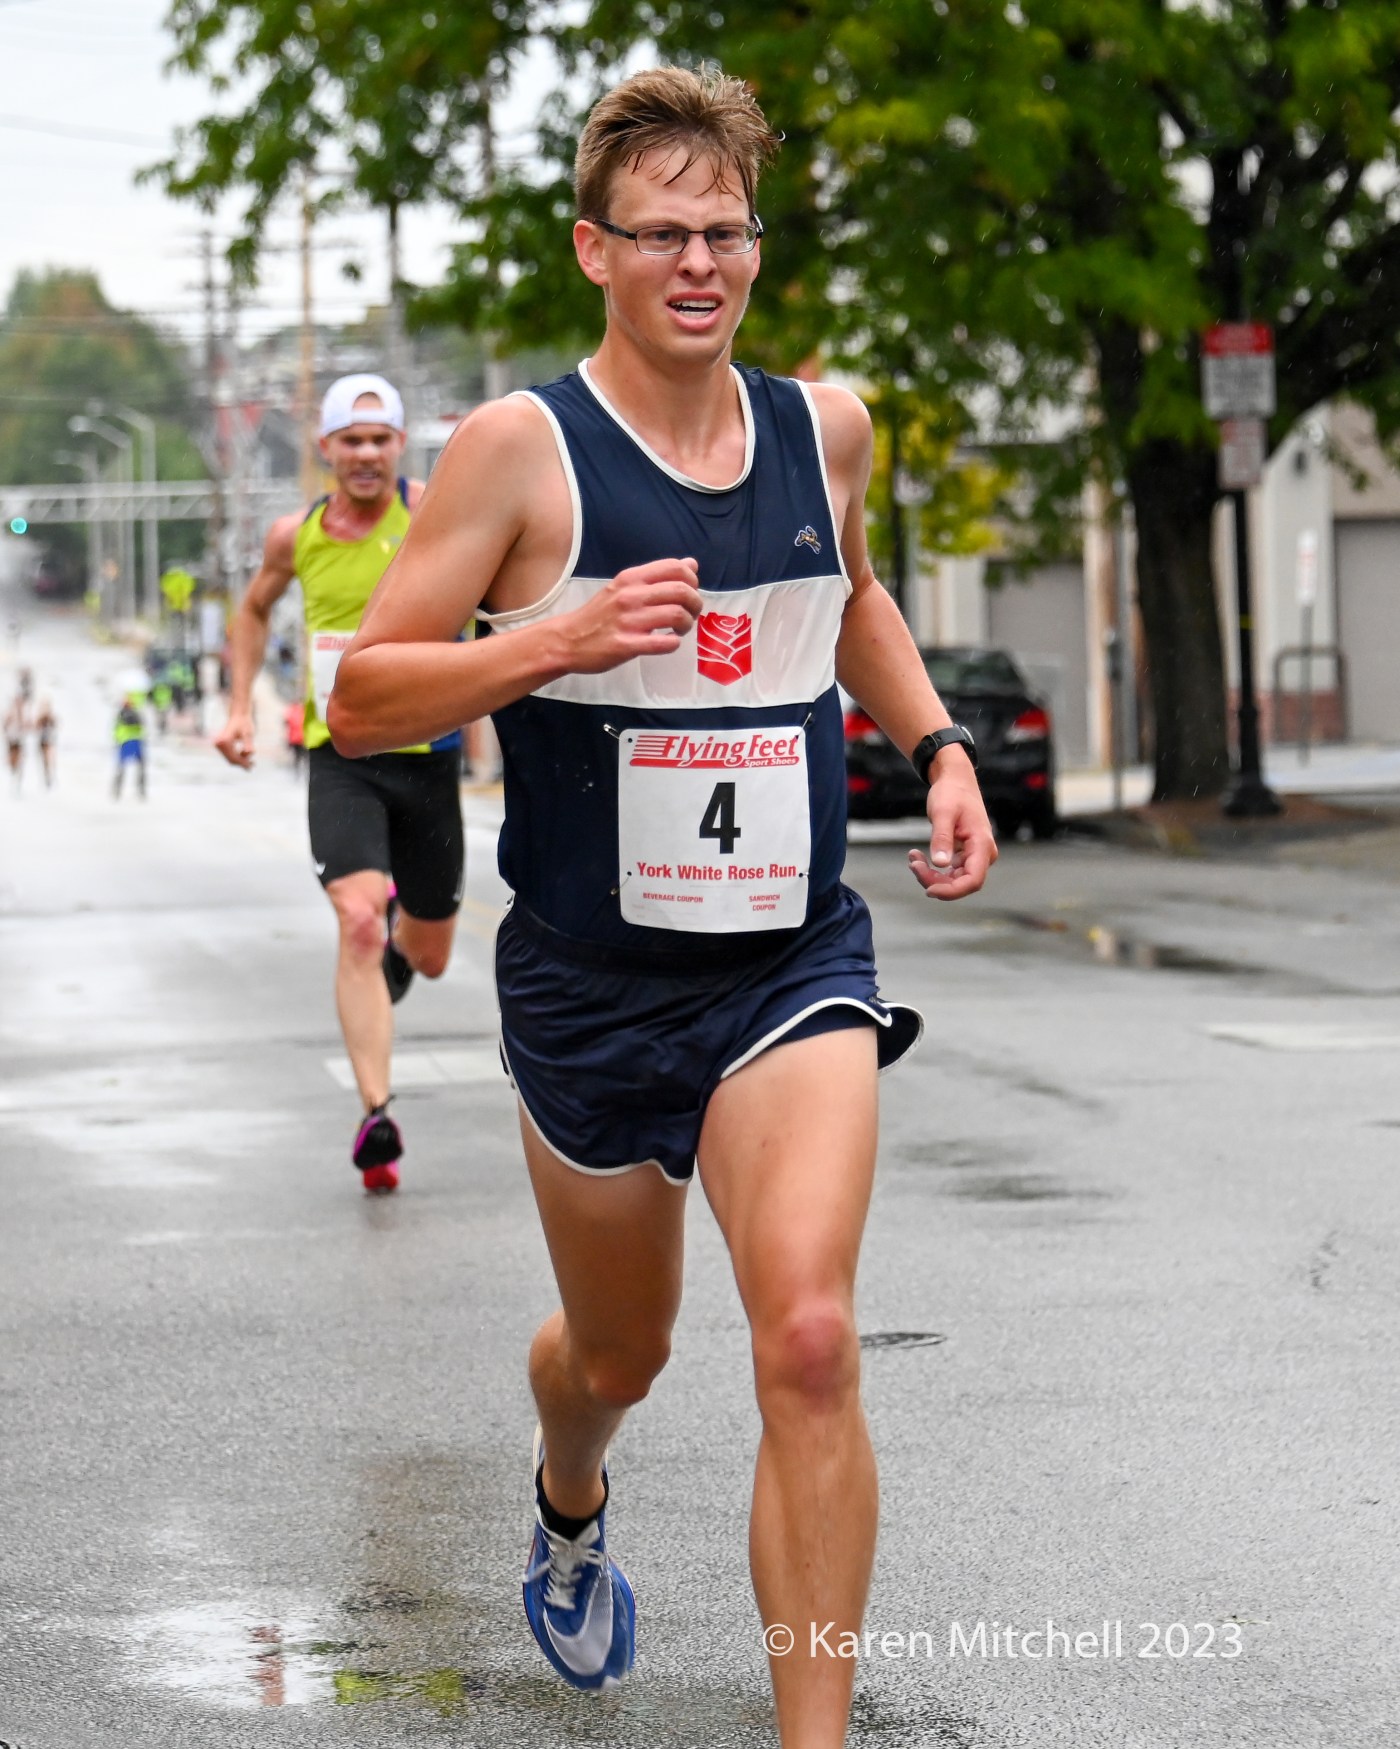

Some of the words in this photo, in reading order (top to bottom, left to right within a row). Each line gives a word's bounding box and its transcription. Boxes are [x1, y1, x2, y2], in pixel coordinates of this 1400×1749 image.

[660, 735, 747, 767] Flying
[748, 734, 798, 757] Feet
[744, 758, 768, 768] Sport
[770, 757, 796, 766] Shoes
[699, 782, 741, 854] 4
[637, 862, 672, 879] York
[677, 865, 723, 880] White
[728, 865, 764, 880] Rose
[769, 863, 797, 879] Run
[643, 892, 675, 902] BEVERAGE
[677, 895, 703, 903] COUPON
[749, 894, 780, 903] SANDWICH
[752, 904, 776, 912] COUPON
